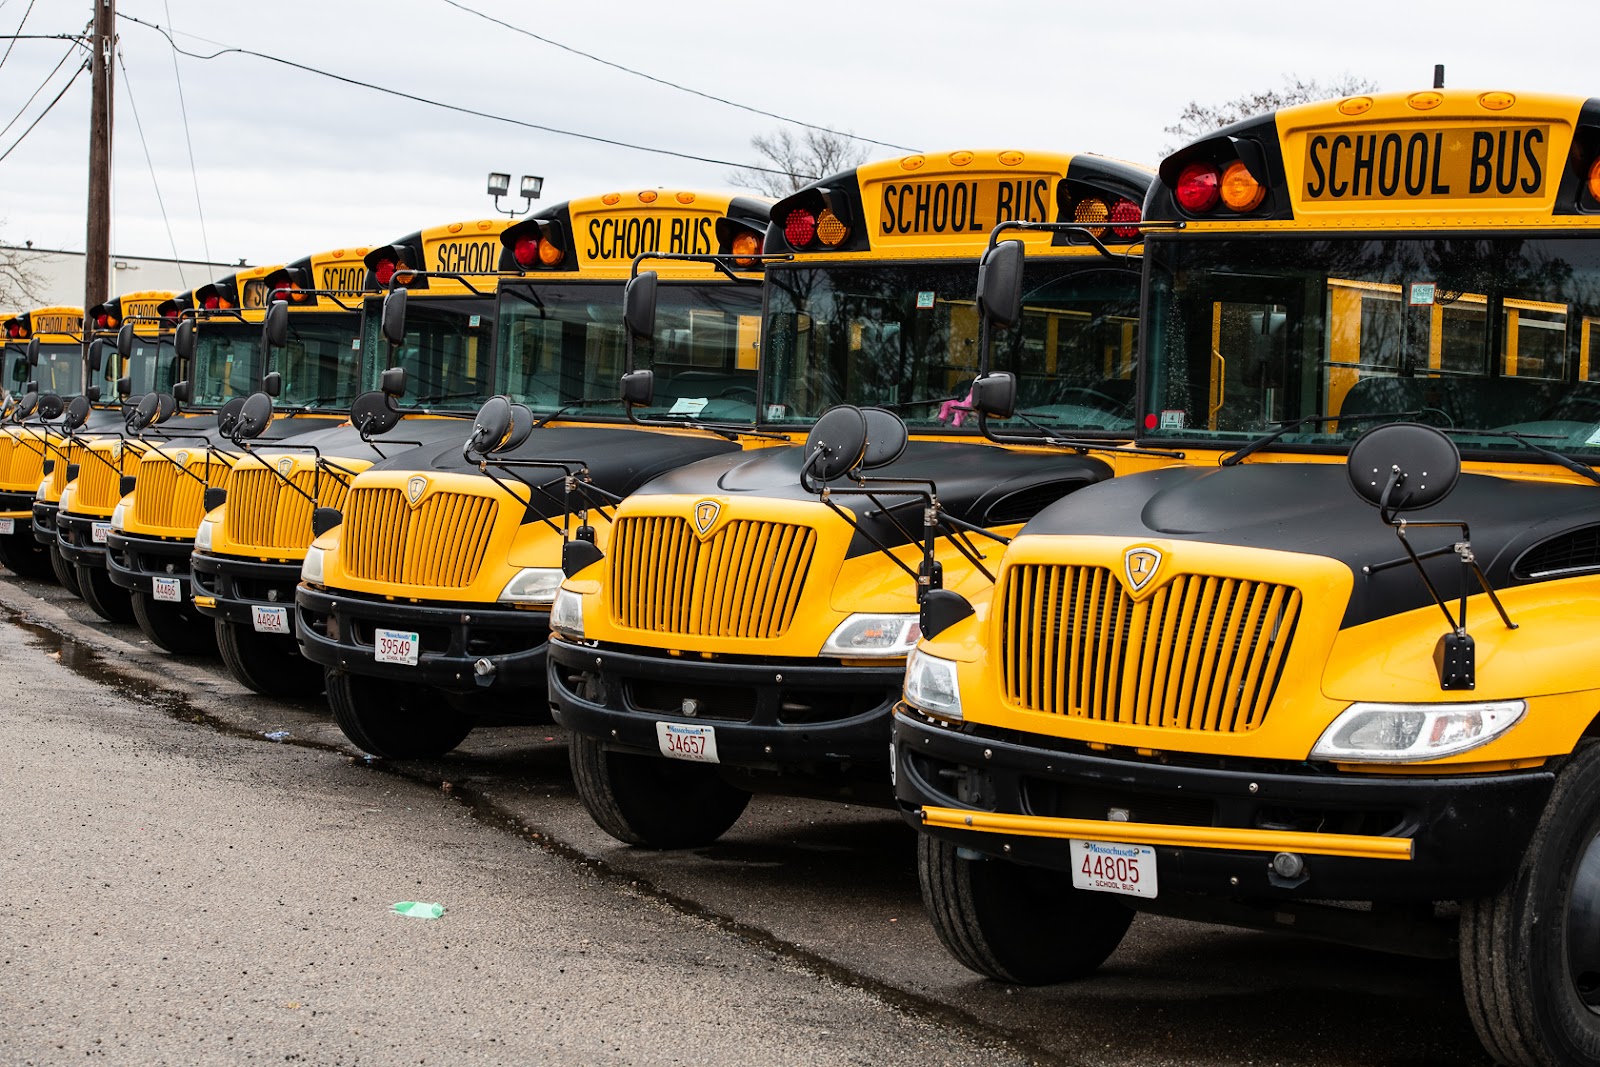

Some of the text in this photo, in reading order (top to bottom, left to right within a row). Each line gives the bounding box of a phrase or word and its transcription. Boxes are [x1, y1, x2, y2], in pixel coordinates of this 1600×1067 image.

[1307, 128, 1544, 198] SCHOOL BUS
[882, 179, 1048, 234] SCHOOL BUS
[587, 217, 712, 260] SCHOOL BUS
[437, 242, 498, 274] SCHOOL
[323, 267, 365, 298] SCHOO
[380, 638, 411, 656] 39549
[666, 733, 706, 755] 34657
[1089, 843, 1137, 858] Massachusetts
[1081, 854, 1140, 884] 44805
[1095, 880, 1135, 891] SCHOOL BUS
